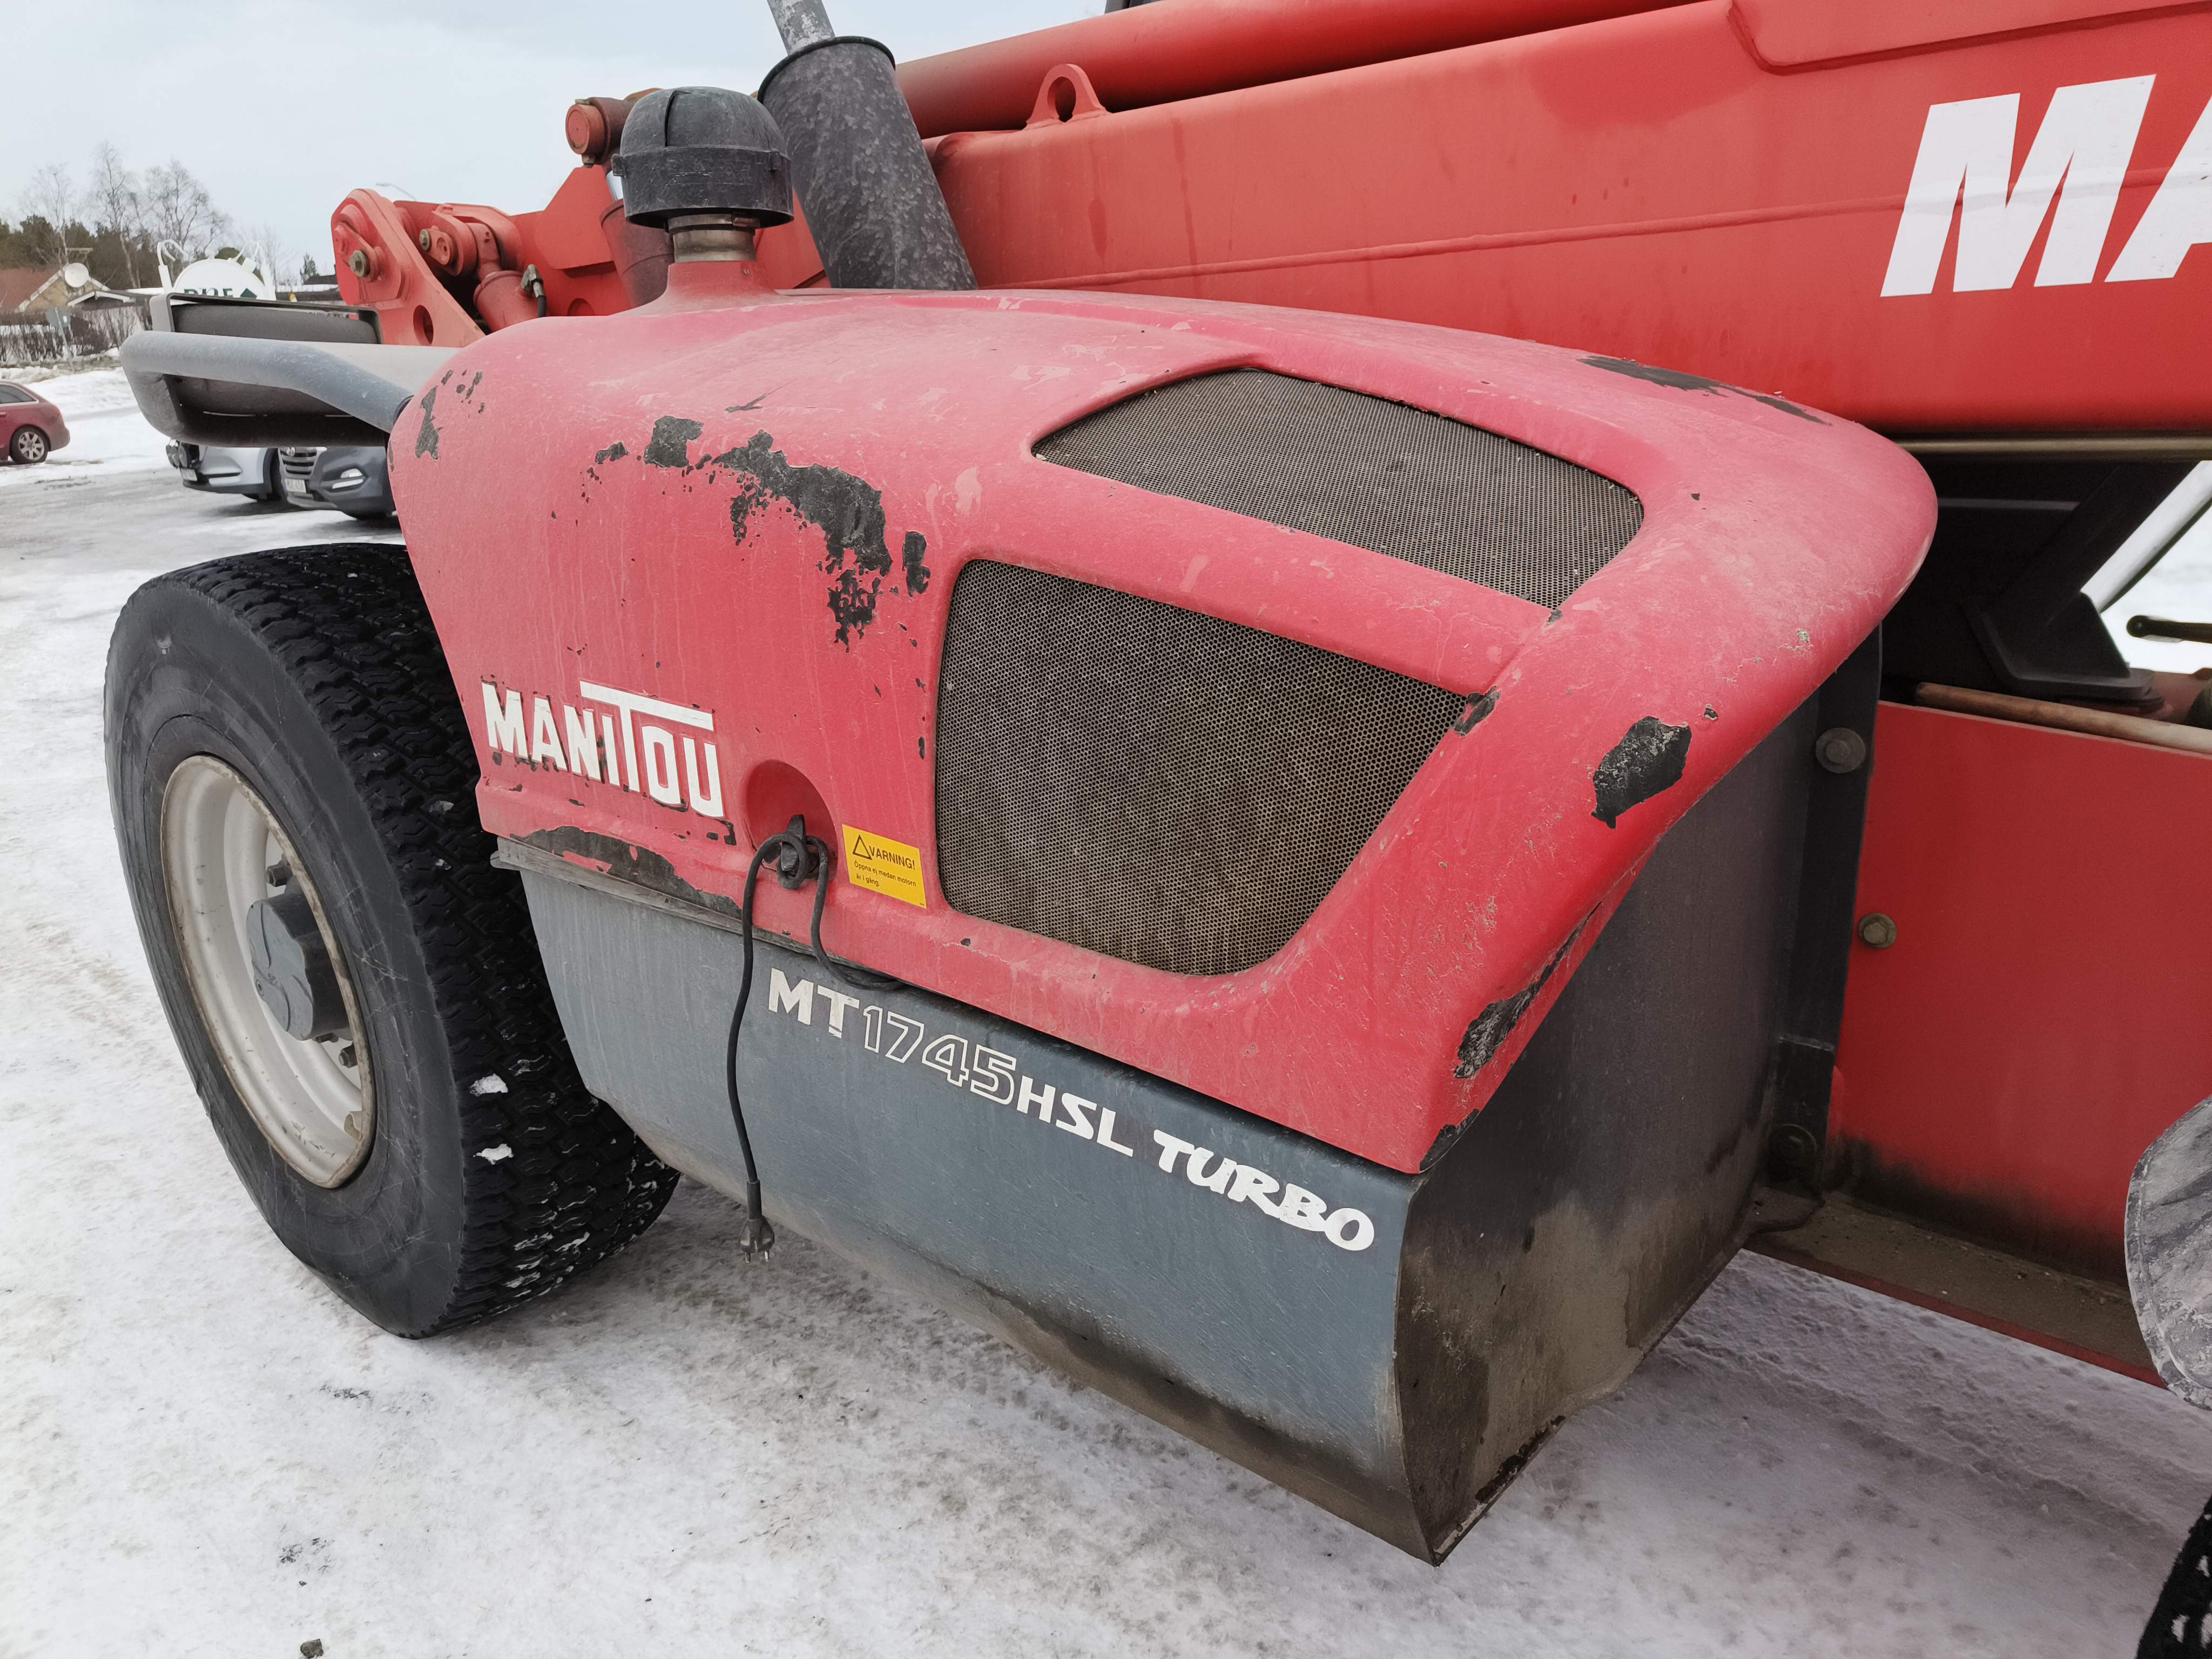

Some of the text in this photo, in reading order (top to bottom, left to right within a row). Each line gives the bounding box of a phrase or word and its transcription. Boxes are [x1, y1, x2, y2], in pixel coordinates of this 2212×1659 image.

[482, 680, 724, 817] MANITOU
[854, 859, 916, 887] Öppna ej medan motorn
[868, 845, 915, 870] VARNING!
[1153, 1129, 1375, 1251] TURBO
